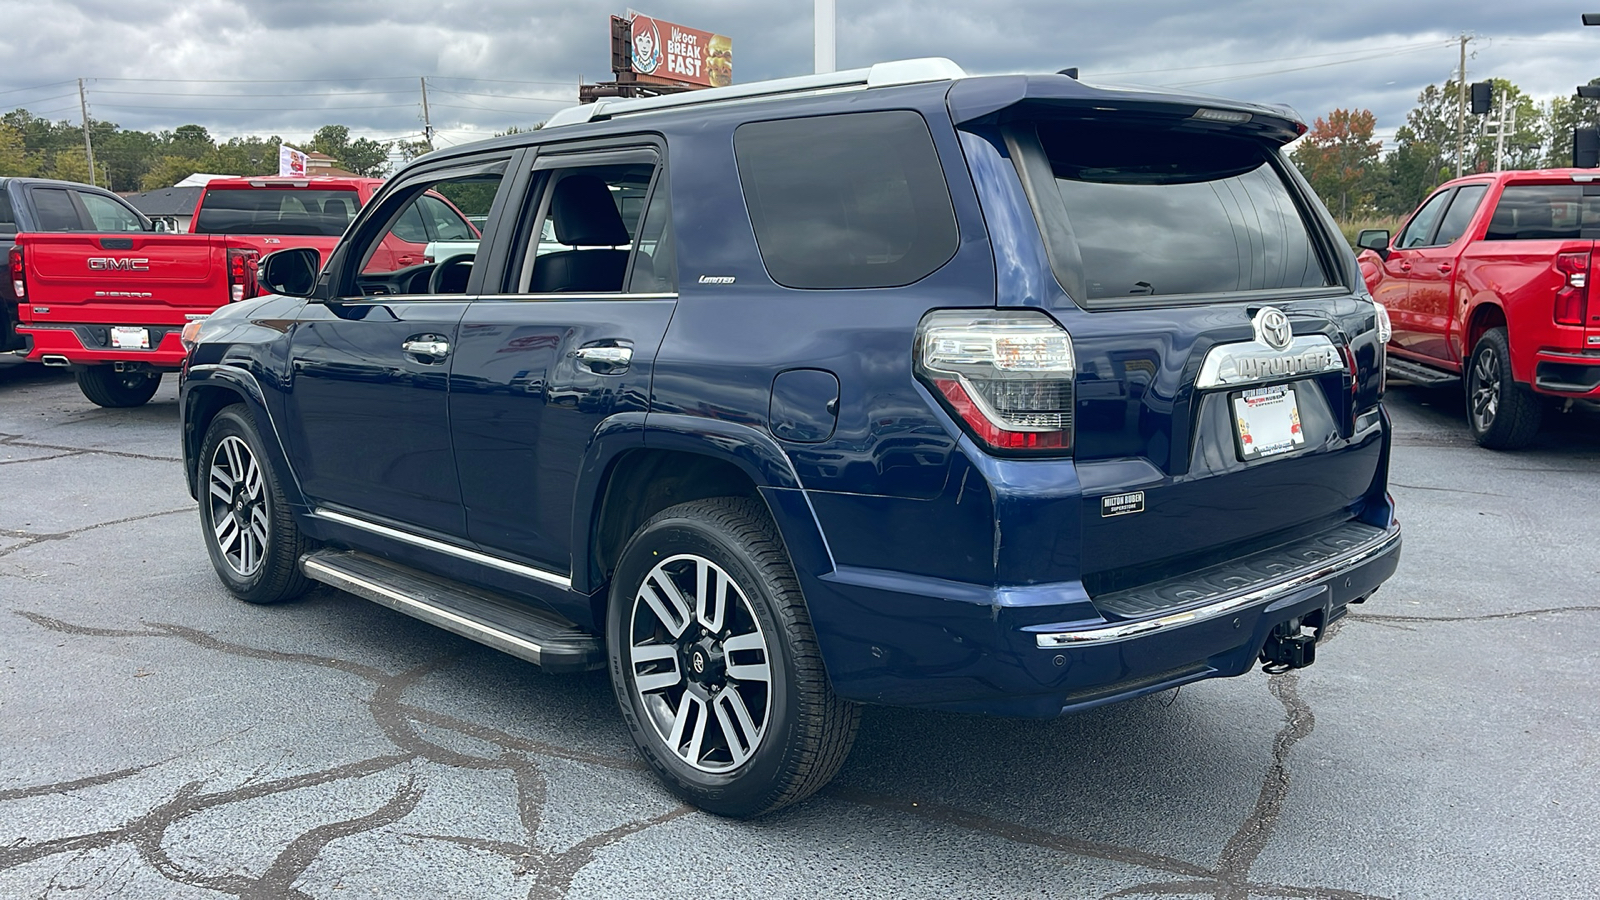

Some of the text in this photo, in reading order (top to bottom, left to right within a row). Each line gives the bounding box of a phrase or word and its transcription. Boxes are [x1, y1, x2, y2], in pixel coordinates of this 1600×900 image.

[671, 26, 697, 46] We GOT
[668, 40, 701, 59] BREAK
[668, 54, 701, 77] FAST
[87, 257, 149, 271] GMC
[1104, 493, 1142, 507] MILTON RUBEN
[1110, 503, 1136, 512] SUPERSTORE
